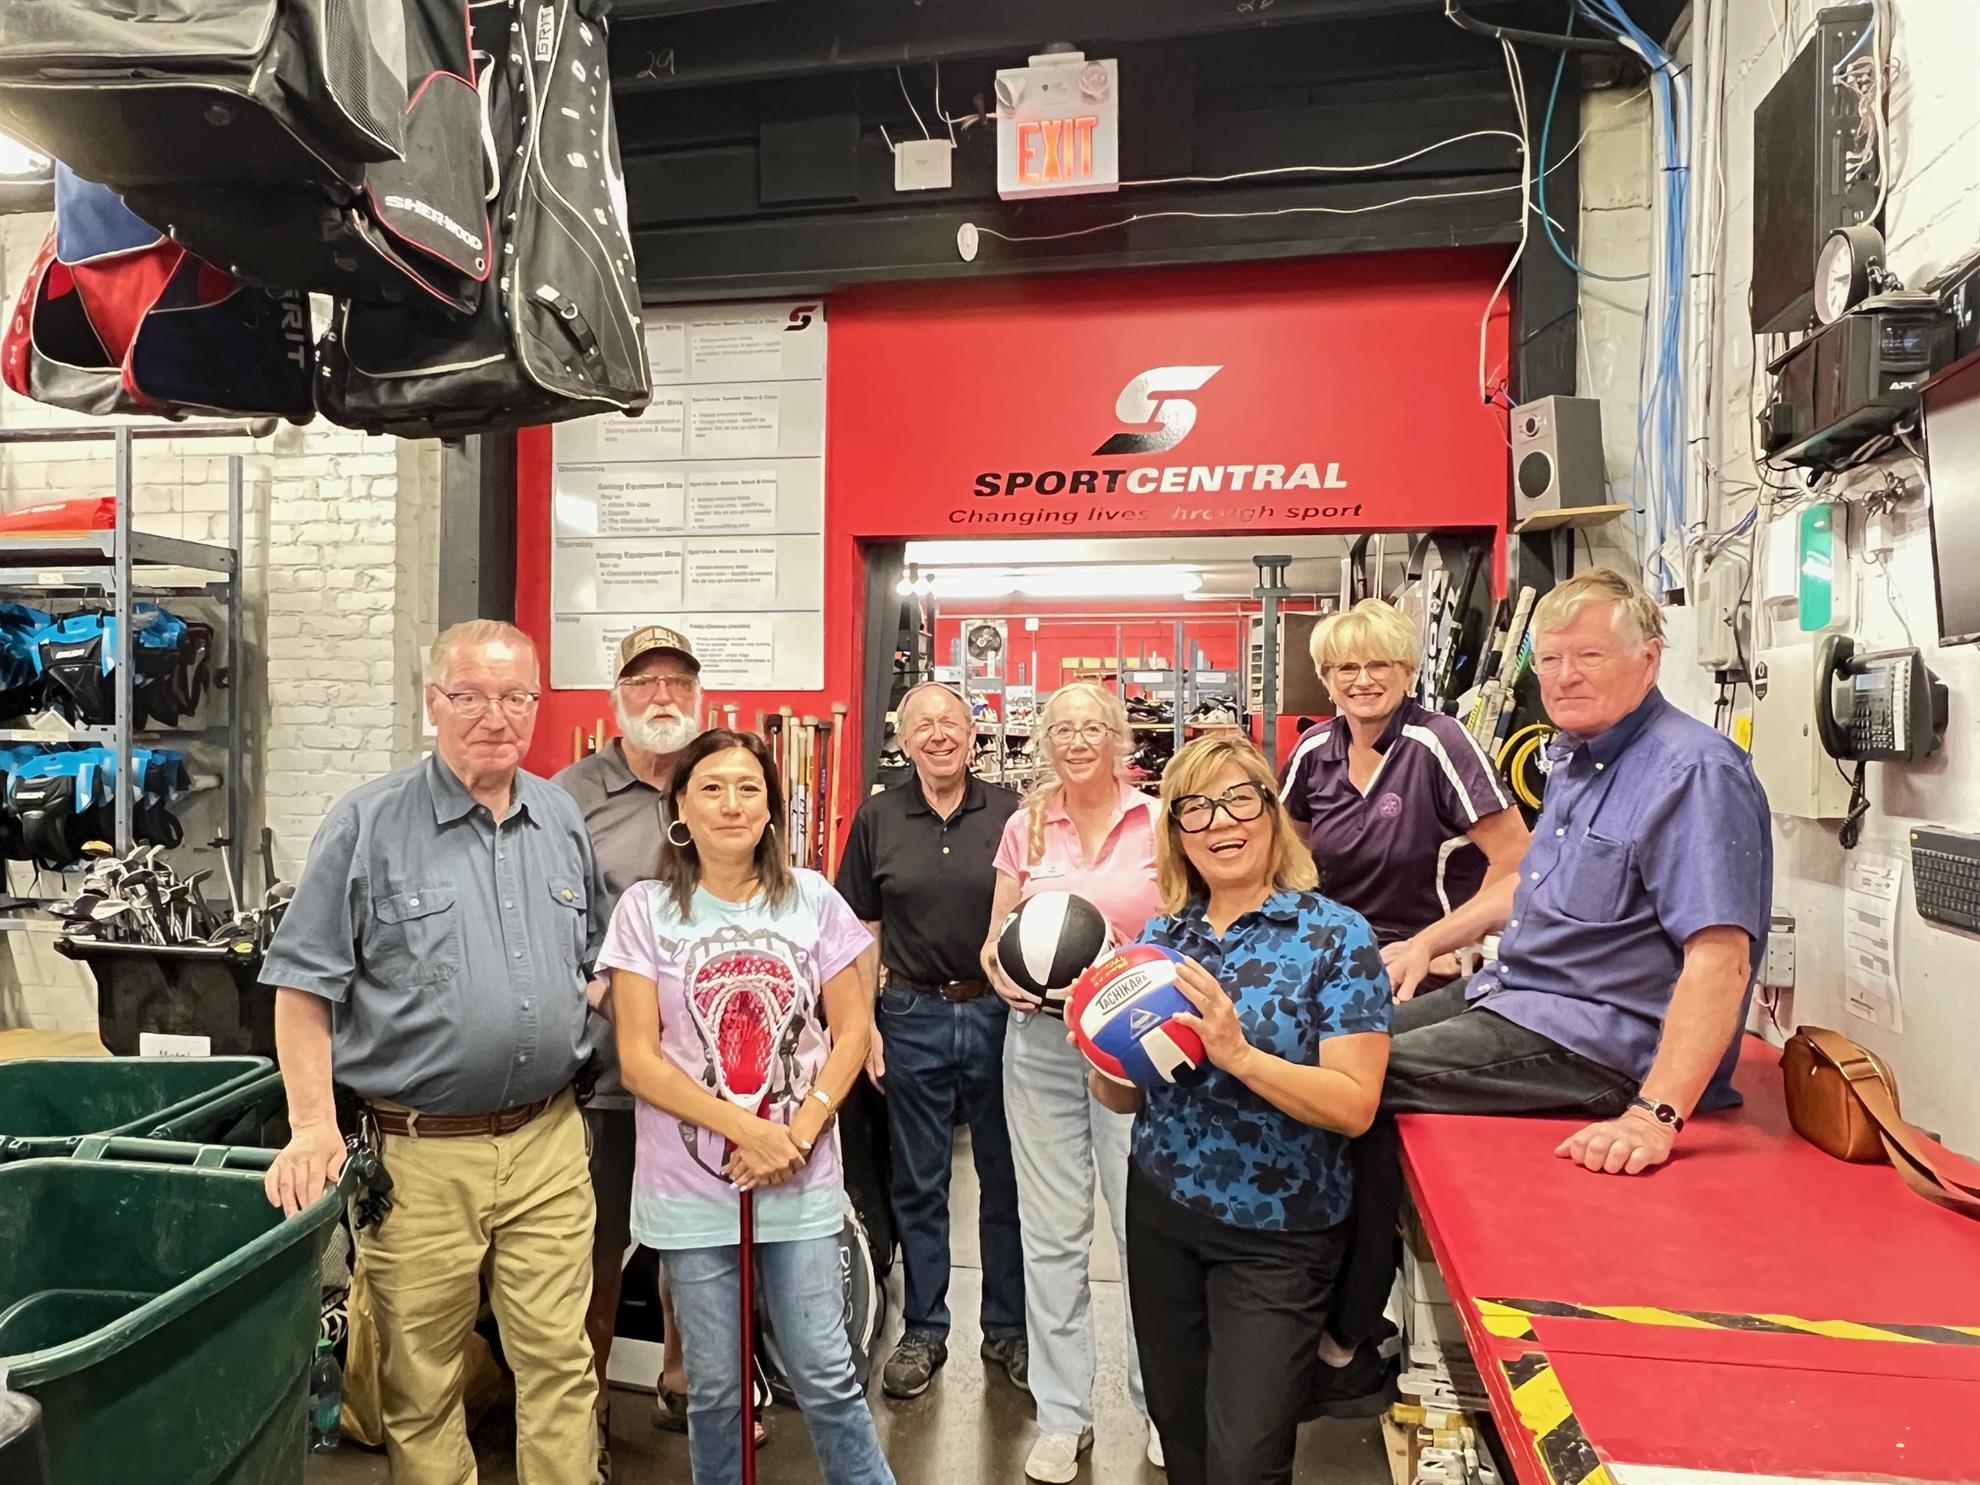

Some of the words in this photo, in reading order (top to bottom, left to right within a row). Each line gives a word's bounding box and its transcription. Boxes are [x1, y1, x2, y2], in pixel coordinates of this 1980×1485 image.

[537, 10, 553, 57] GRIT
[1016, 116, 1099, 184] EXIT
[948, 508, 1078, 526] Changing
[1088, 507, 1149, 522] lives
[1167, 505, 1275, 523] hrogh
[1285, 503, 1362, 521] sport
